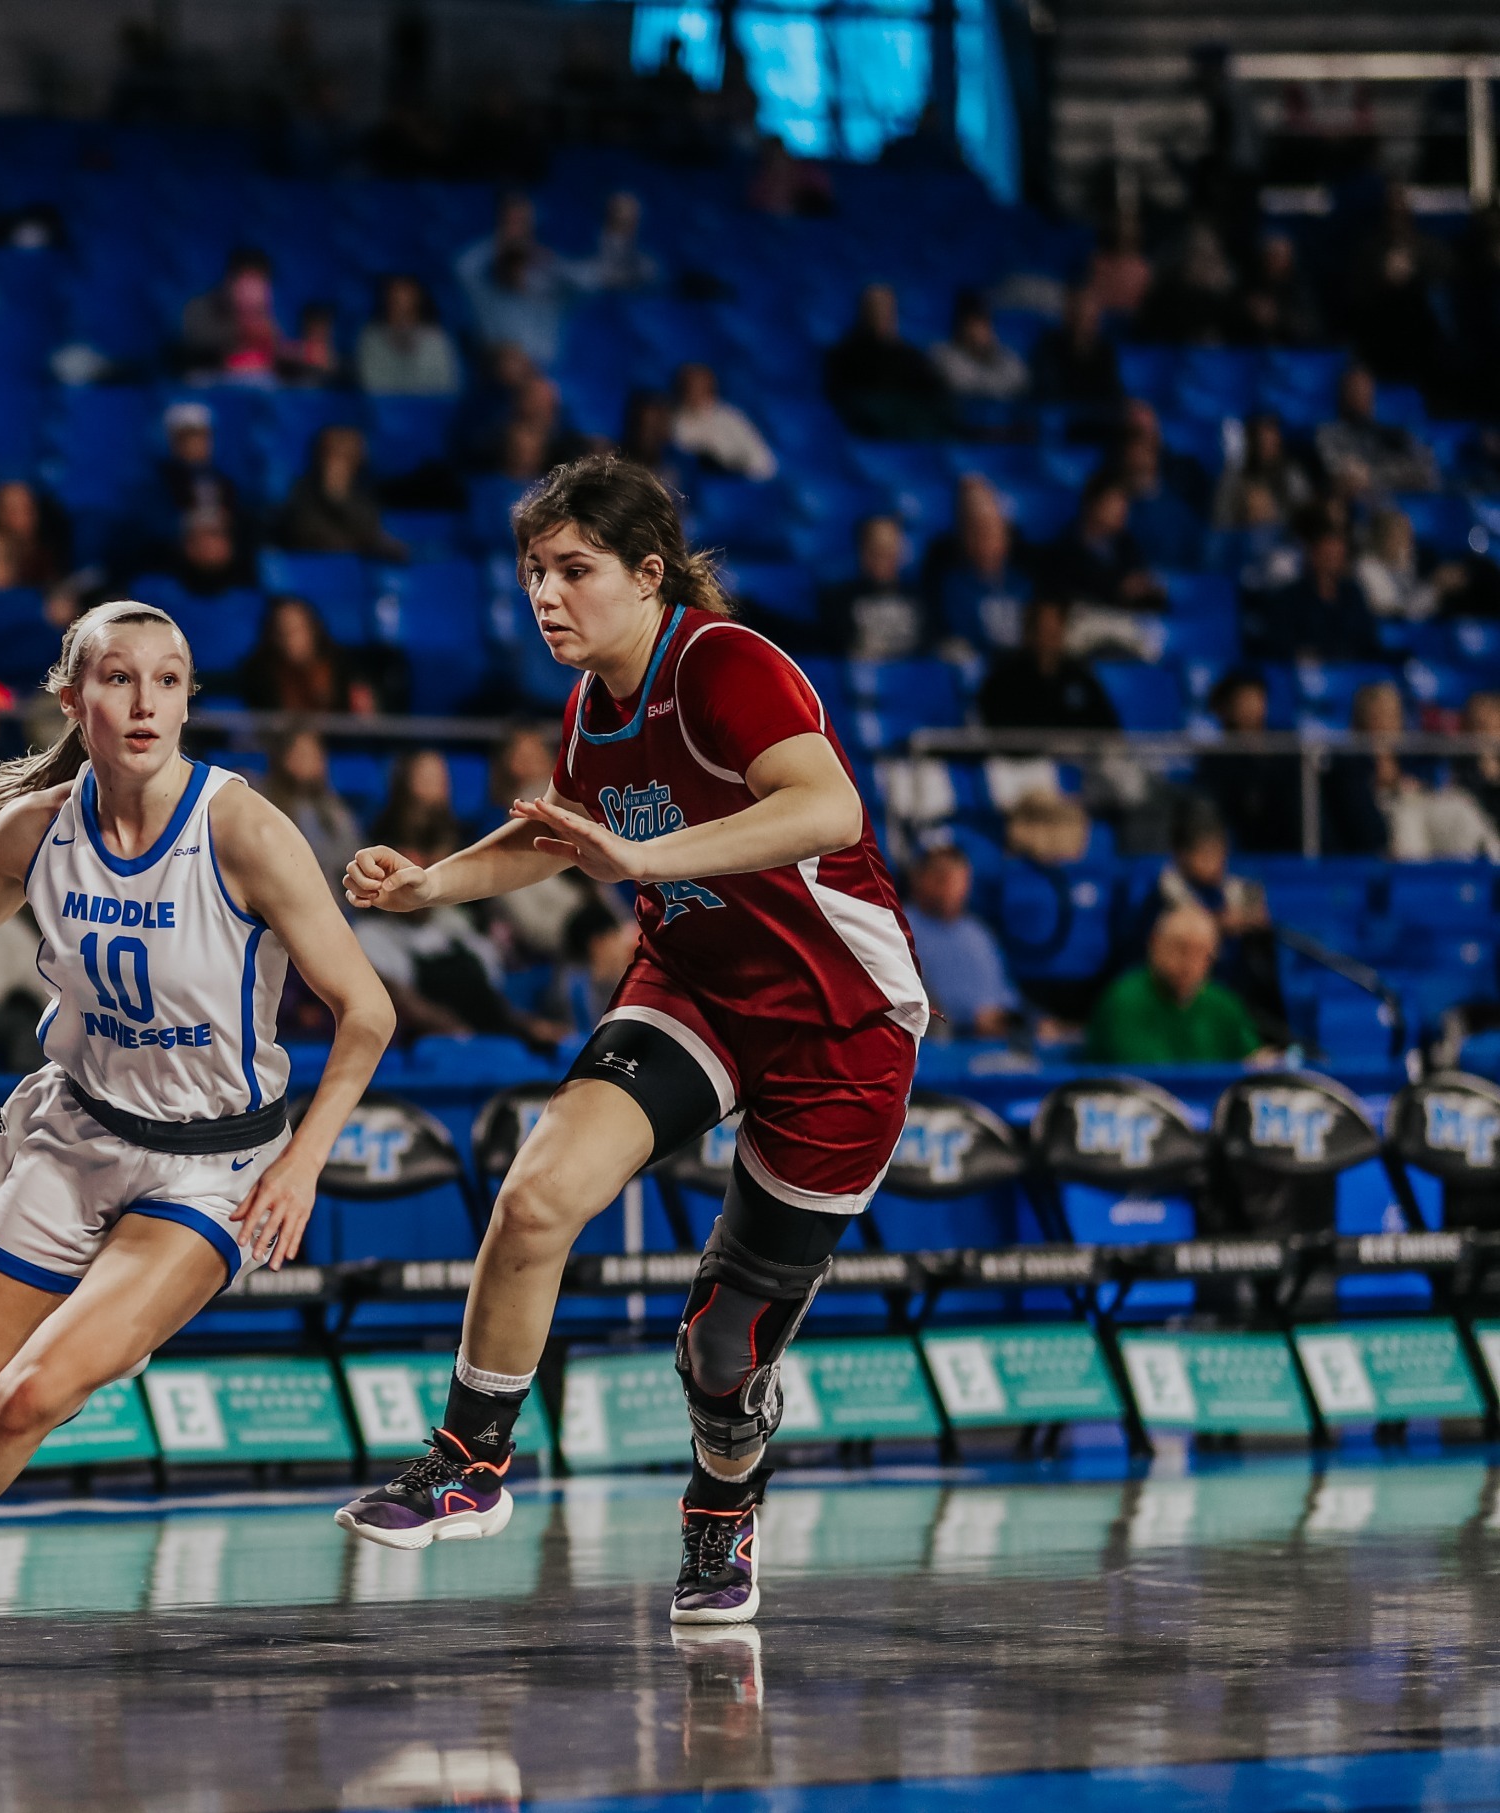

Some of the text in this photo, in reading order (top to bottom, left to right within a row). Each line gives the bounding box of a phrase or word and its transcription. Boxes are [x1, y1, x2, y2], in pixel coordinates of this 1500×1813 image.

[598, 779, 685, 843] State
[624, 795, 640, 807] NEW
[61, 890, 176, 929] MIDDLE
[79, 931, 156, 1025] 10
